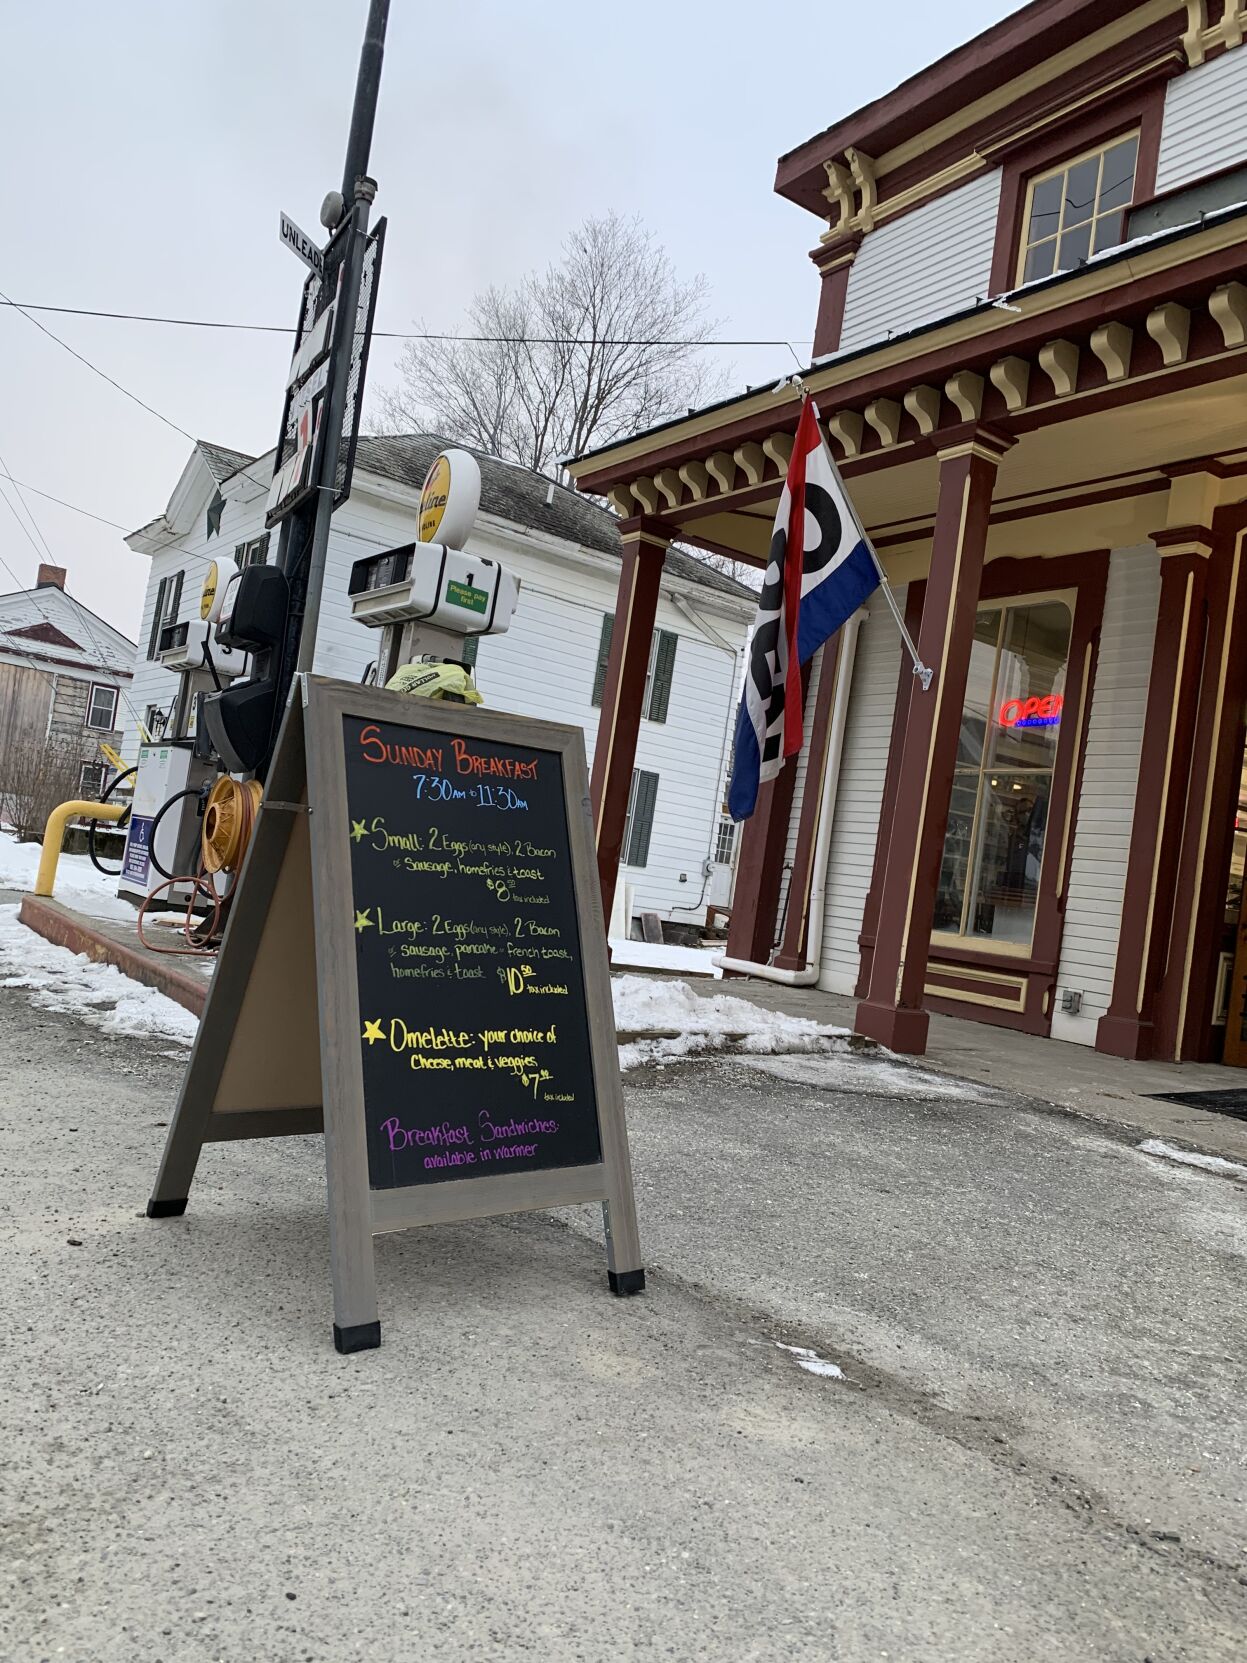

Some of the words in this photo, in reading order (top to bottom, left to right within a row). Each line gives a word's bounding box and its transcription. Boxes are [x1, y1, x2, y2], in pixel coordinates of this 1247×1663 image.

[282, 219, 323, 275] UNLEADE
[450, 584, 472, 597] Please
[466, 573, 475, 587] 1
[361, 725, 443, 771] SUNDAY
[451, 739, 538, 780] BREAKFAST
[469, 789, 477, 797] to
[372, 816, 425, 851] Small:
[429, 827, 442, 850] 2
[515, 840, 525, 857] 2
[524, 841, 557, 859] Bacon
[457, 858, 505, 876] homefries
[513, 866, 544, 880] toast
[377, 907, 428, 940] Large:
[432, 914, 444, 934] 2
[514, 917, 525, 938] 2
[524, 920, 560, 938] Bacon
[454, 943, 498, 961] pancake
[390, 962, 444, 978] homefries
[455, 963, 486, 980] toast
[540, 983, 569, 995] included
[390, 1018, 476, 1052] Omelette:
[478, 1030, 508, 1052] your
[510, 1028, 544, 1043] choice
[546, 1024, 556, 1044] of
[455, 1056, 487, 1069] meat
[494, 1054, 538, 1075] veggies
[380, 1117, 474, 1150] Breakfast
[424, 1151, 477, 1169] available
[480, 1148, 491, 1161] in
[494, 1144, 538, 1160] warmer
